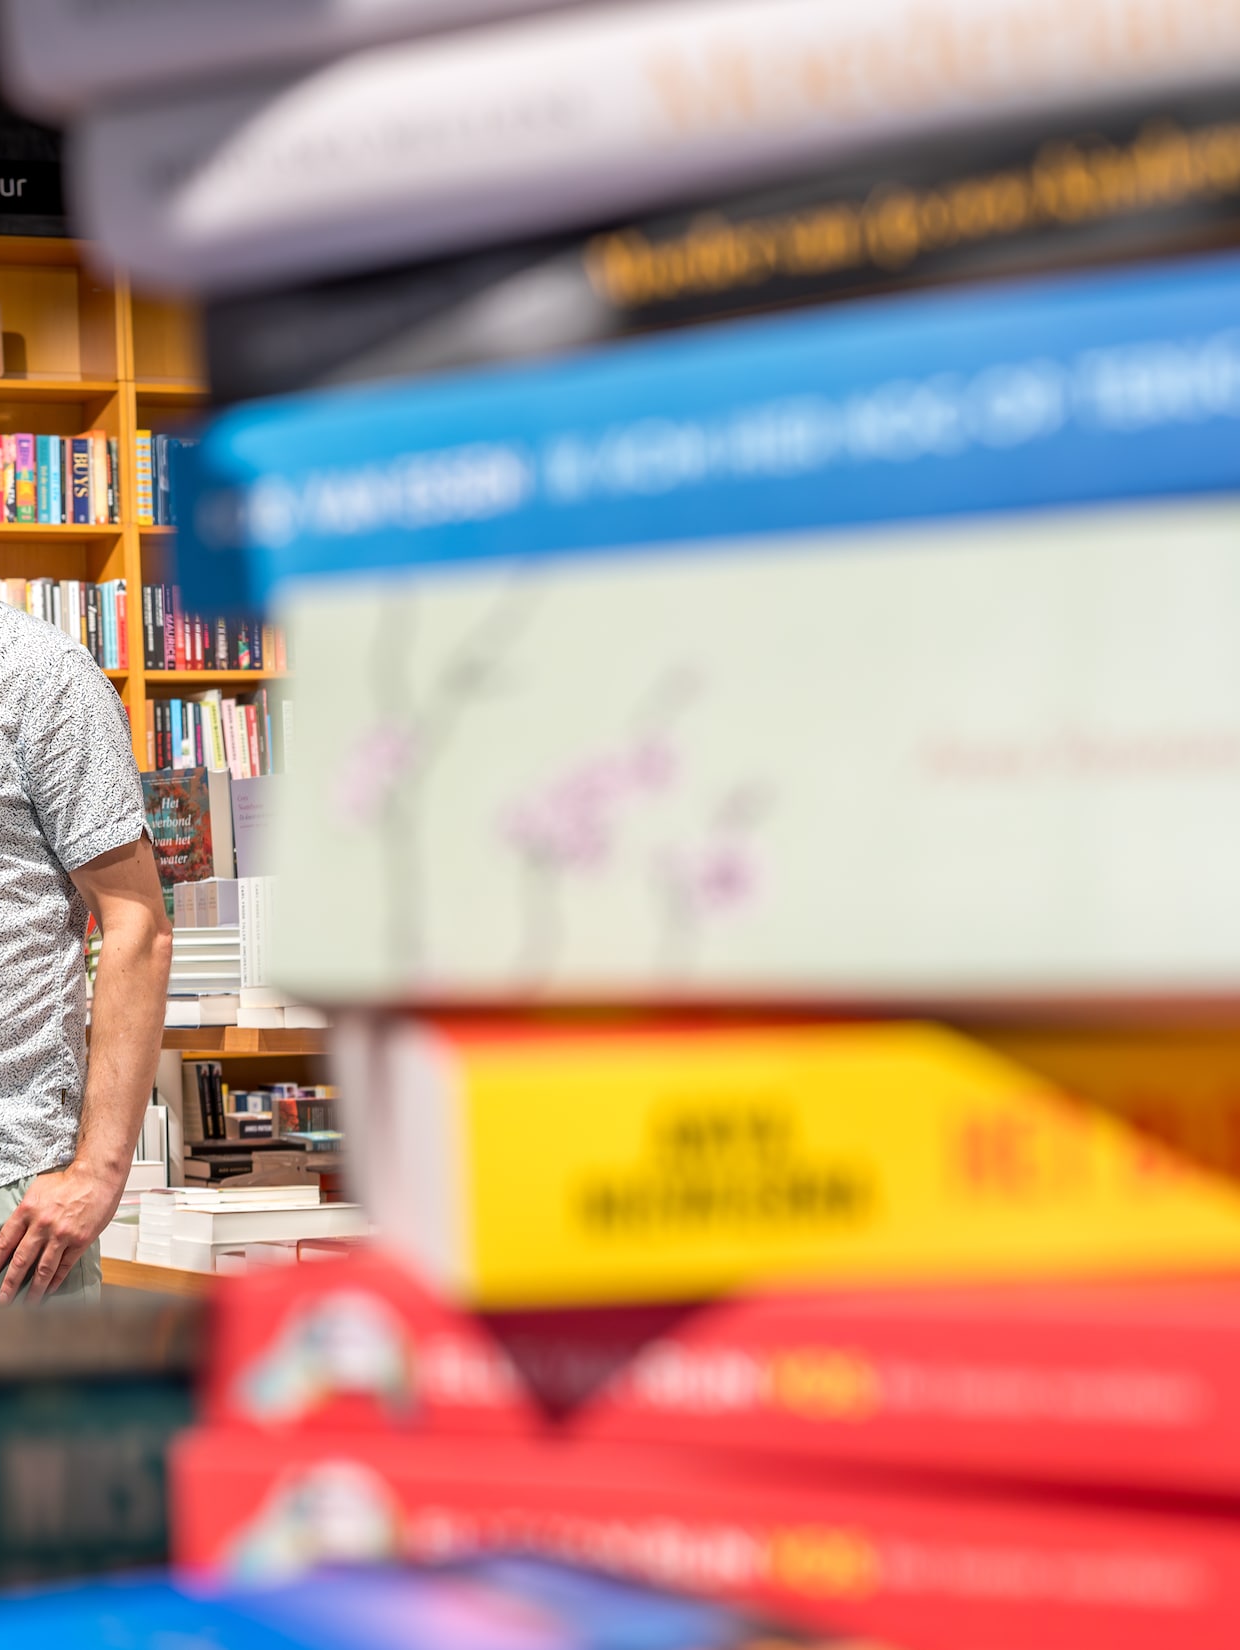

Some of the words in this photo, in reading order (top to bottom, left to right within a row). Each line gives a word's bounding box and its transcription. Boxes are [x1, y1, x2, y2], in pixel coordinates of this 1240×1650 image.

[72, 452, 89, 498] BUYS
[161, 797, 179, 809] Het
[152, 814, 192, 829] verbond
[154, 837, 173, 848] van
[175, 834, 191, 846] het
[160, 855, 189, 866] water
